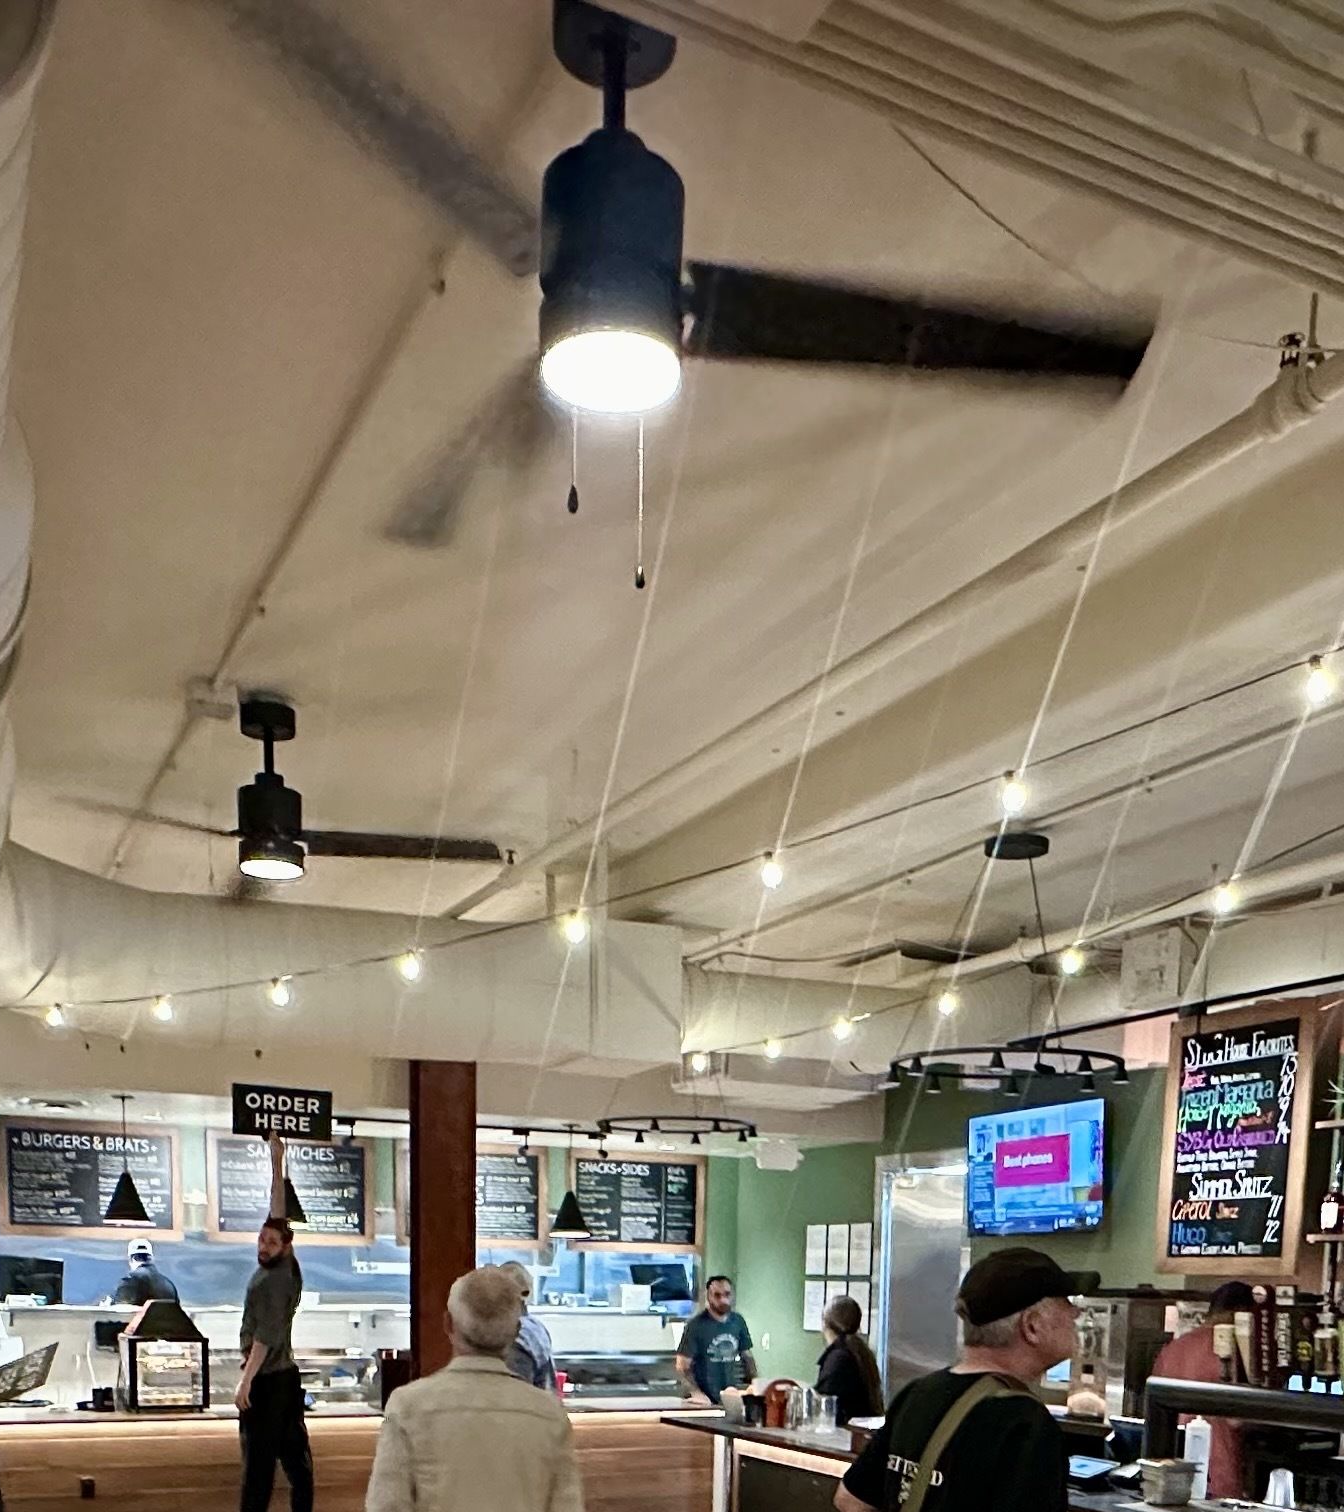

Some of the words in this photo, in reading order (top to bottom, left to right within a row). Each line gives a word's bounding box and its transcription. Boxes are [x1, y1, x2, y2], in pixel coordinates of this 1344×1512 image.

[245, 1091, 320, 1114] ORDER
[255, 1112, 311, 1132] HERE
[20, 1131, 91, 1150] BURGERS
[92, 1135, 104, 1151] &
[105, 1136, 150, 1153] BRATS
[246, 1143, 336, 1162] SANWICHES
[578, 1161, 617, 1175] SNACKS
[622, 1163, 650, 1176] SIDES
